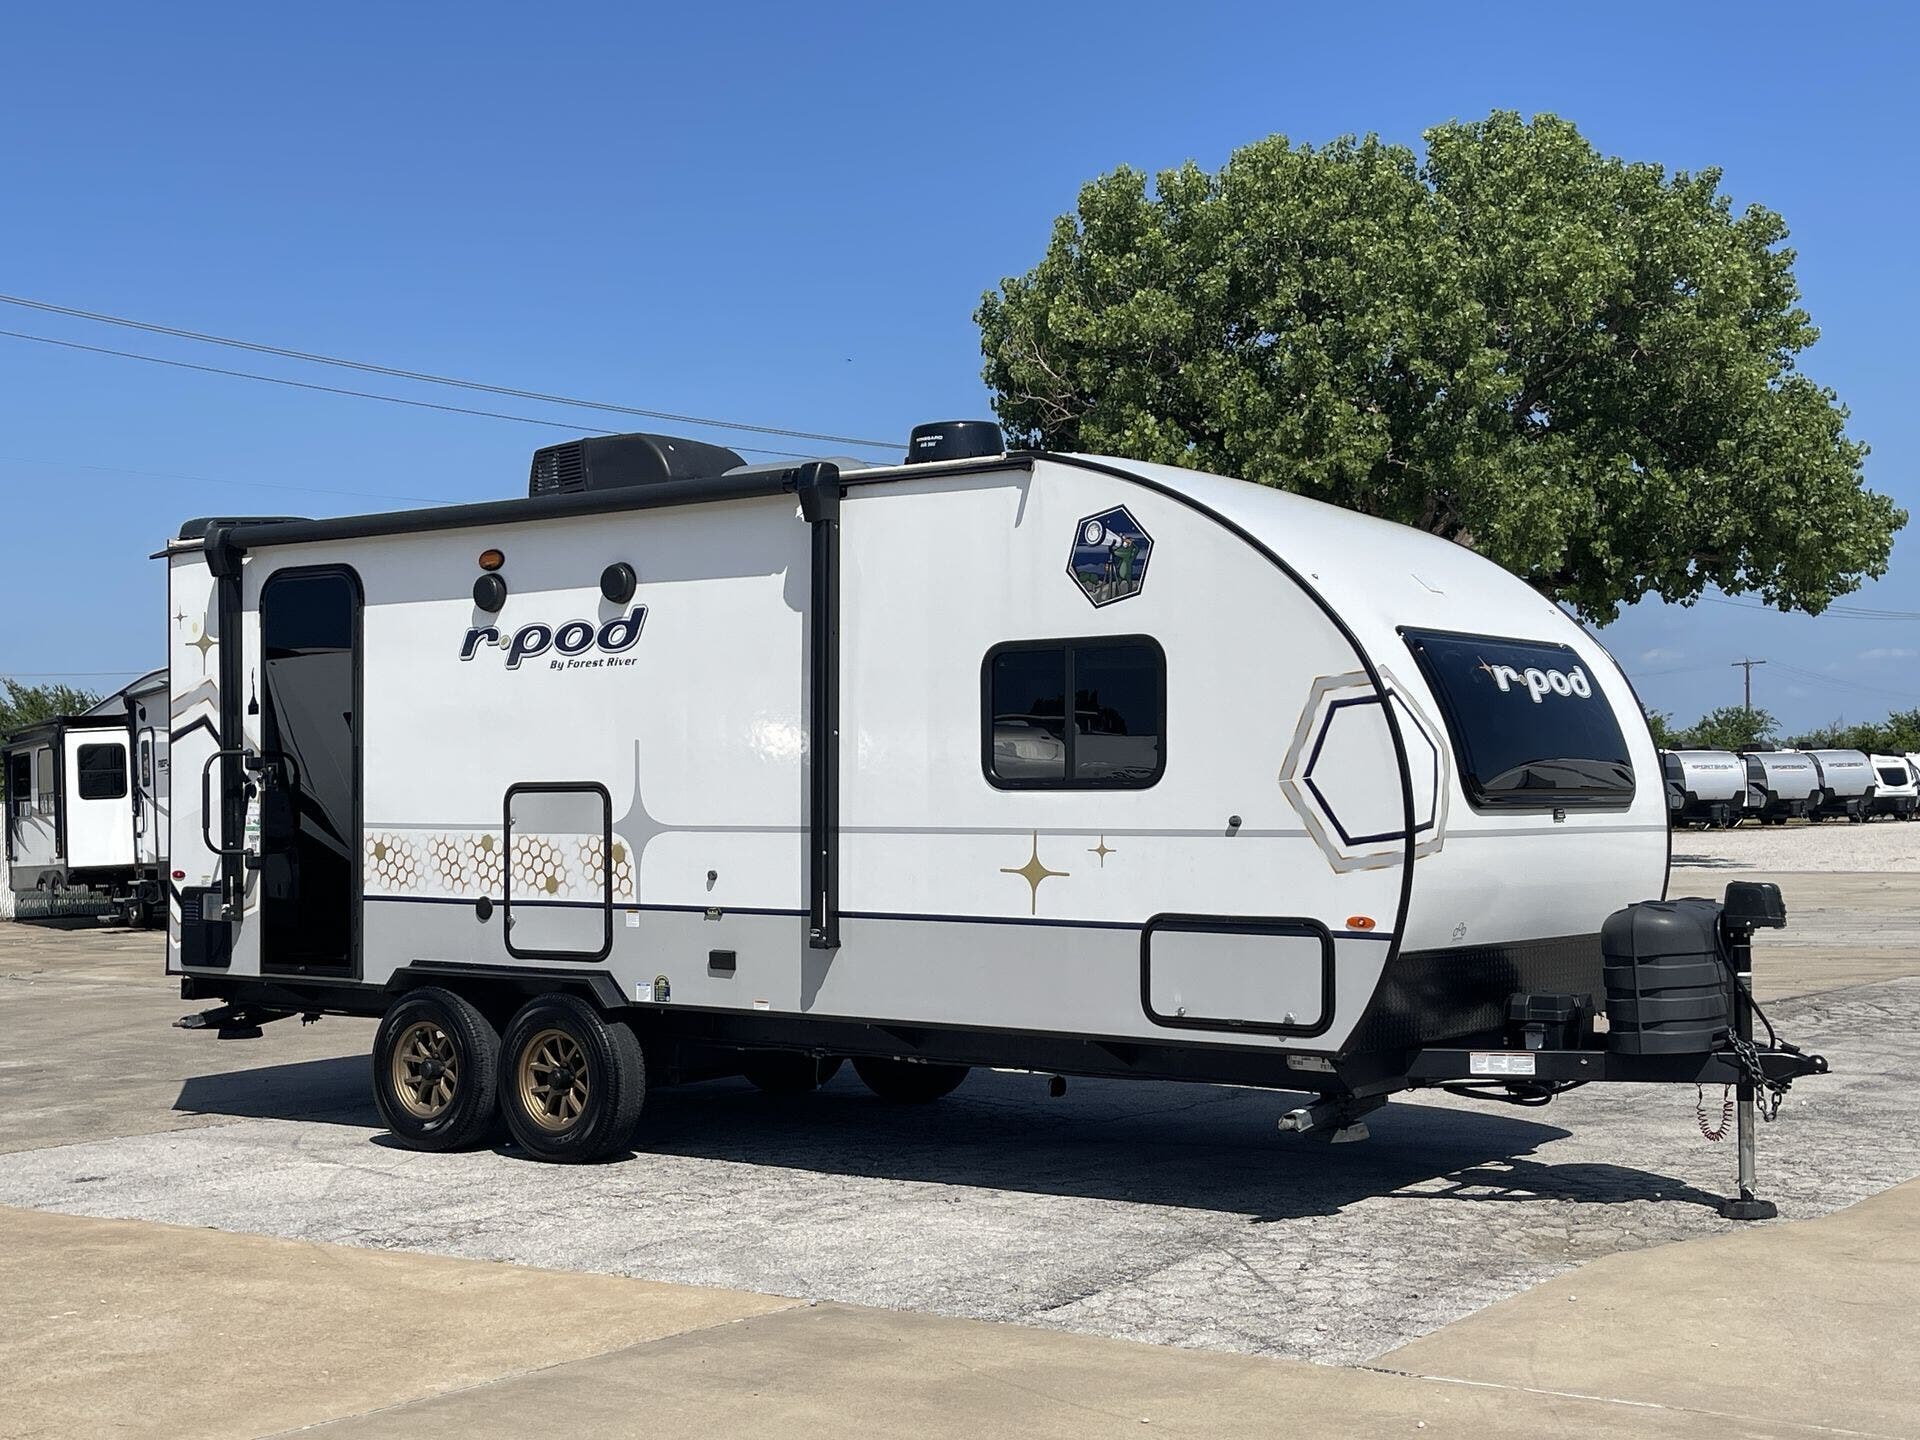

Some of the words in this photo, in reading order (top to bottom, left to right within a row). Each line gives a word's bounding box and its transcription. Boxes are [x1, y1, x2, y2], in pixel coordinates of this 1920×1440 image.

[550, 660, 564, 671] By
[567, 659, 604, 668] Forest
[606, 657, 638, 667] River
